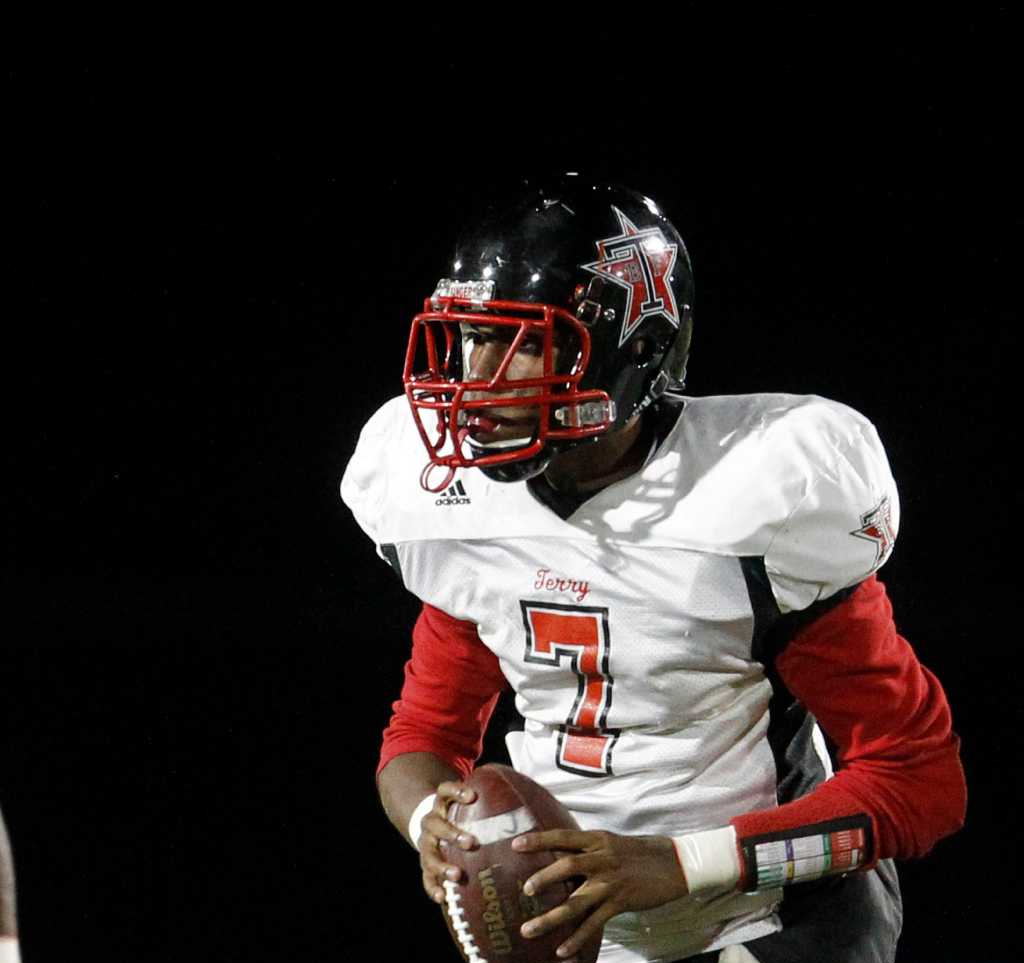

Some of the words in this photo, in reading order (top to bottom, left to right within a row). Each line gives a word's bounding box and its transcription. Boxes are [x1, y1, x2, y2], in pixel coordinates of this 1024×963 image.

[435, 496, 471, 506] adidas
[534, 568, 591, 602] Terry
[519, 600, 622, 778] 7
